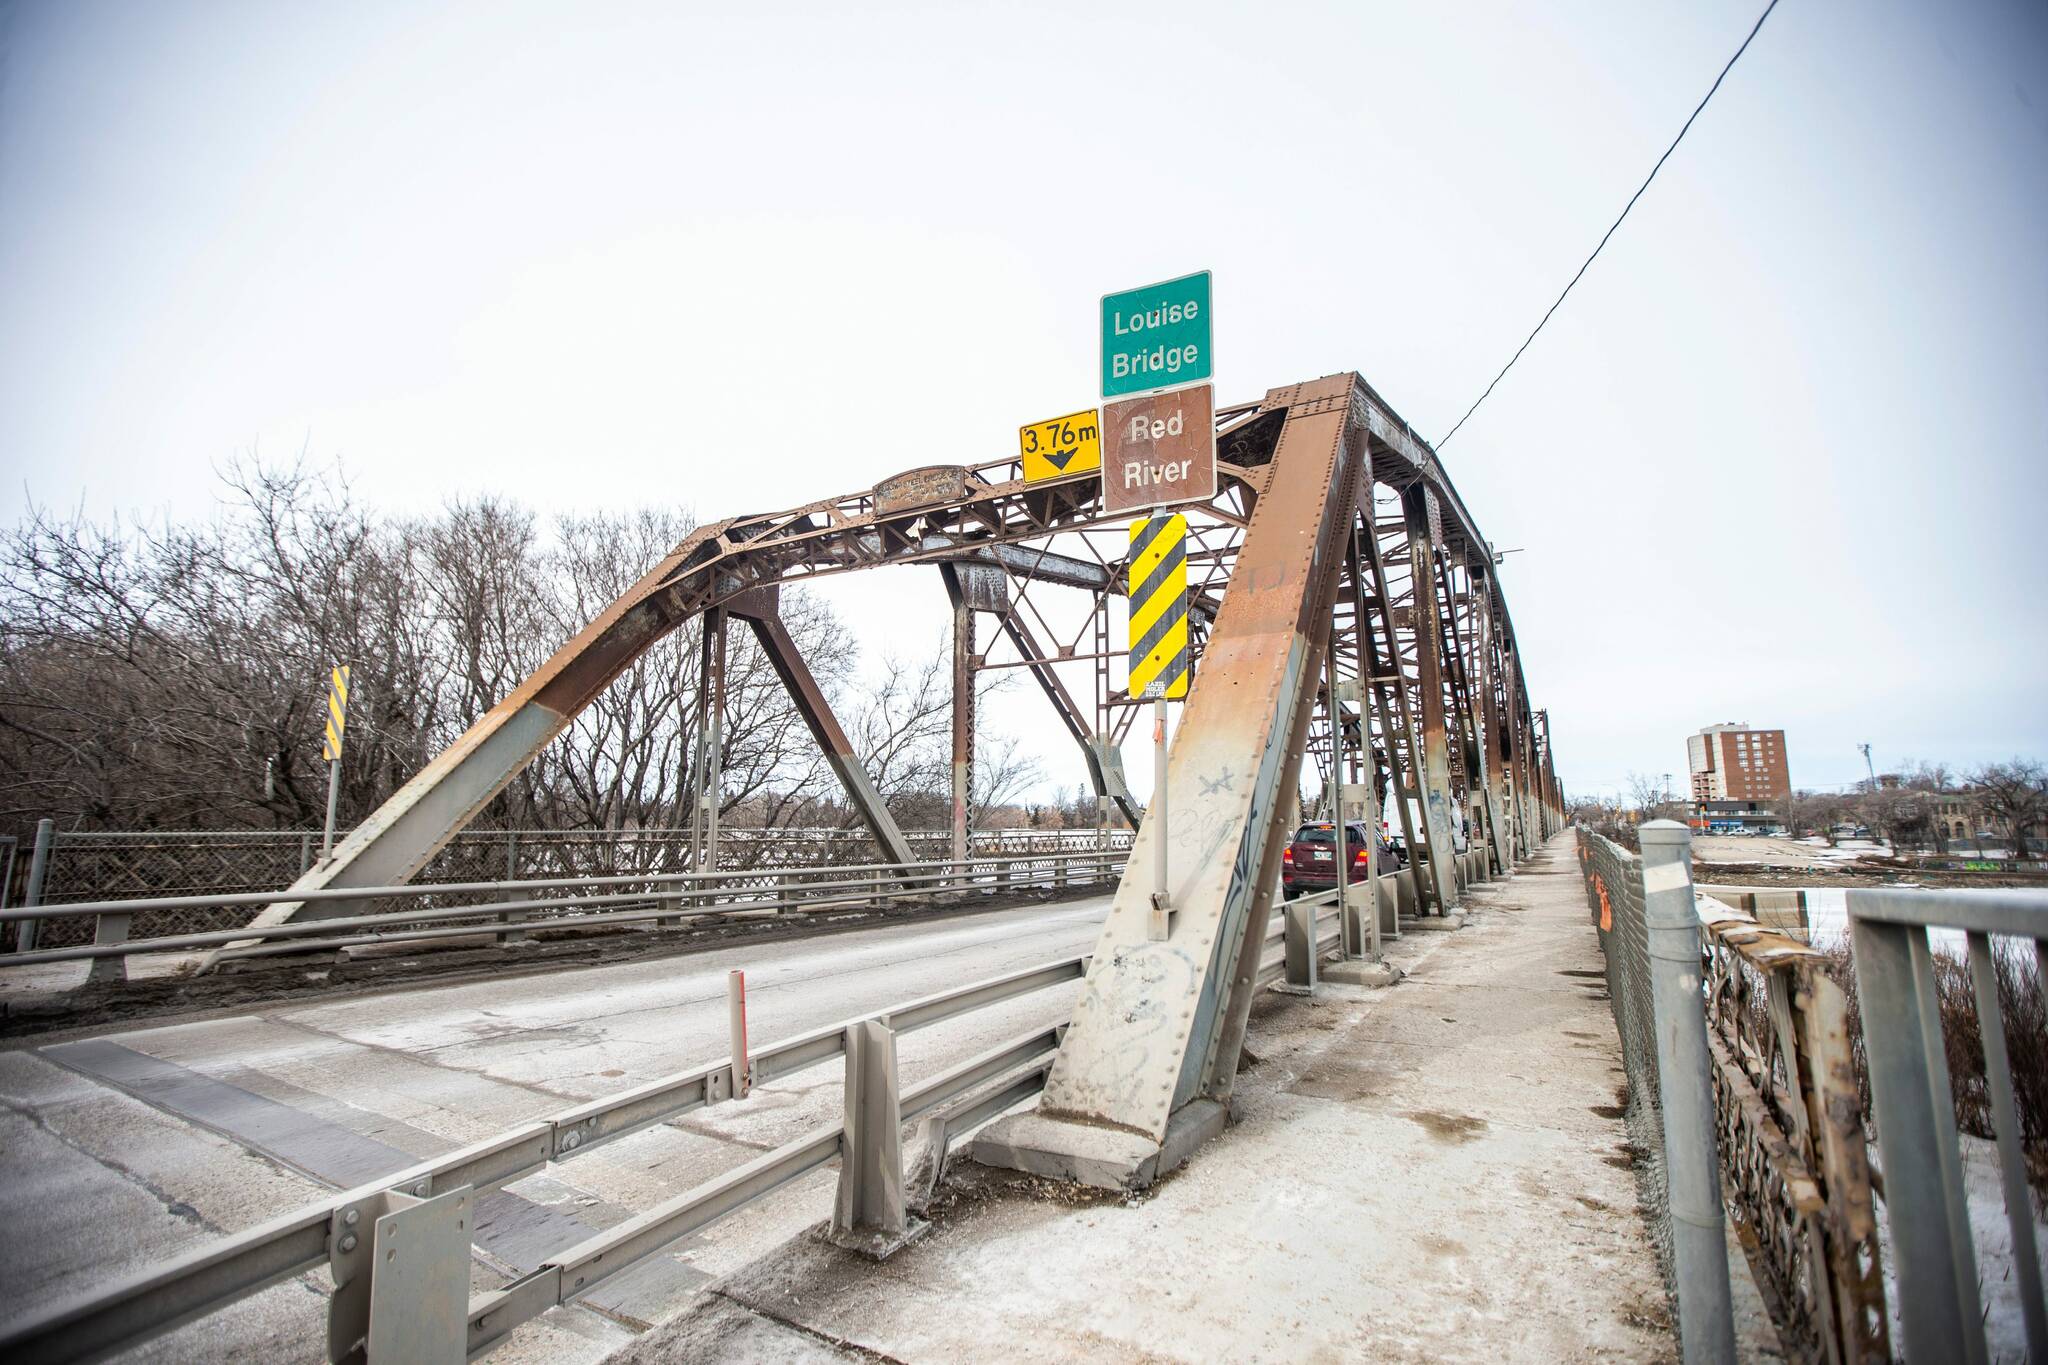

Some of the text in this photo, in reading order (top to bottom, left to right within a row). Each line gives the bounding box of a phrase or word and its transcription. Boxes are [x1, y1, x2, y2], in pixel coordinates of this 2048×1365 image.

[1114, 300, 1199, 336] Louise
[1112, 344, 1198, 378] Bridge
[1025, 421, 1097, 453] 3.76m
[1131, 409, 1184, 441] Red
[1124, 459, 1192, 489] River
